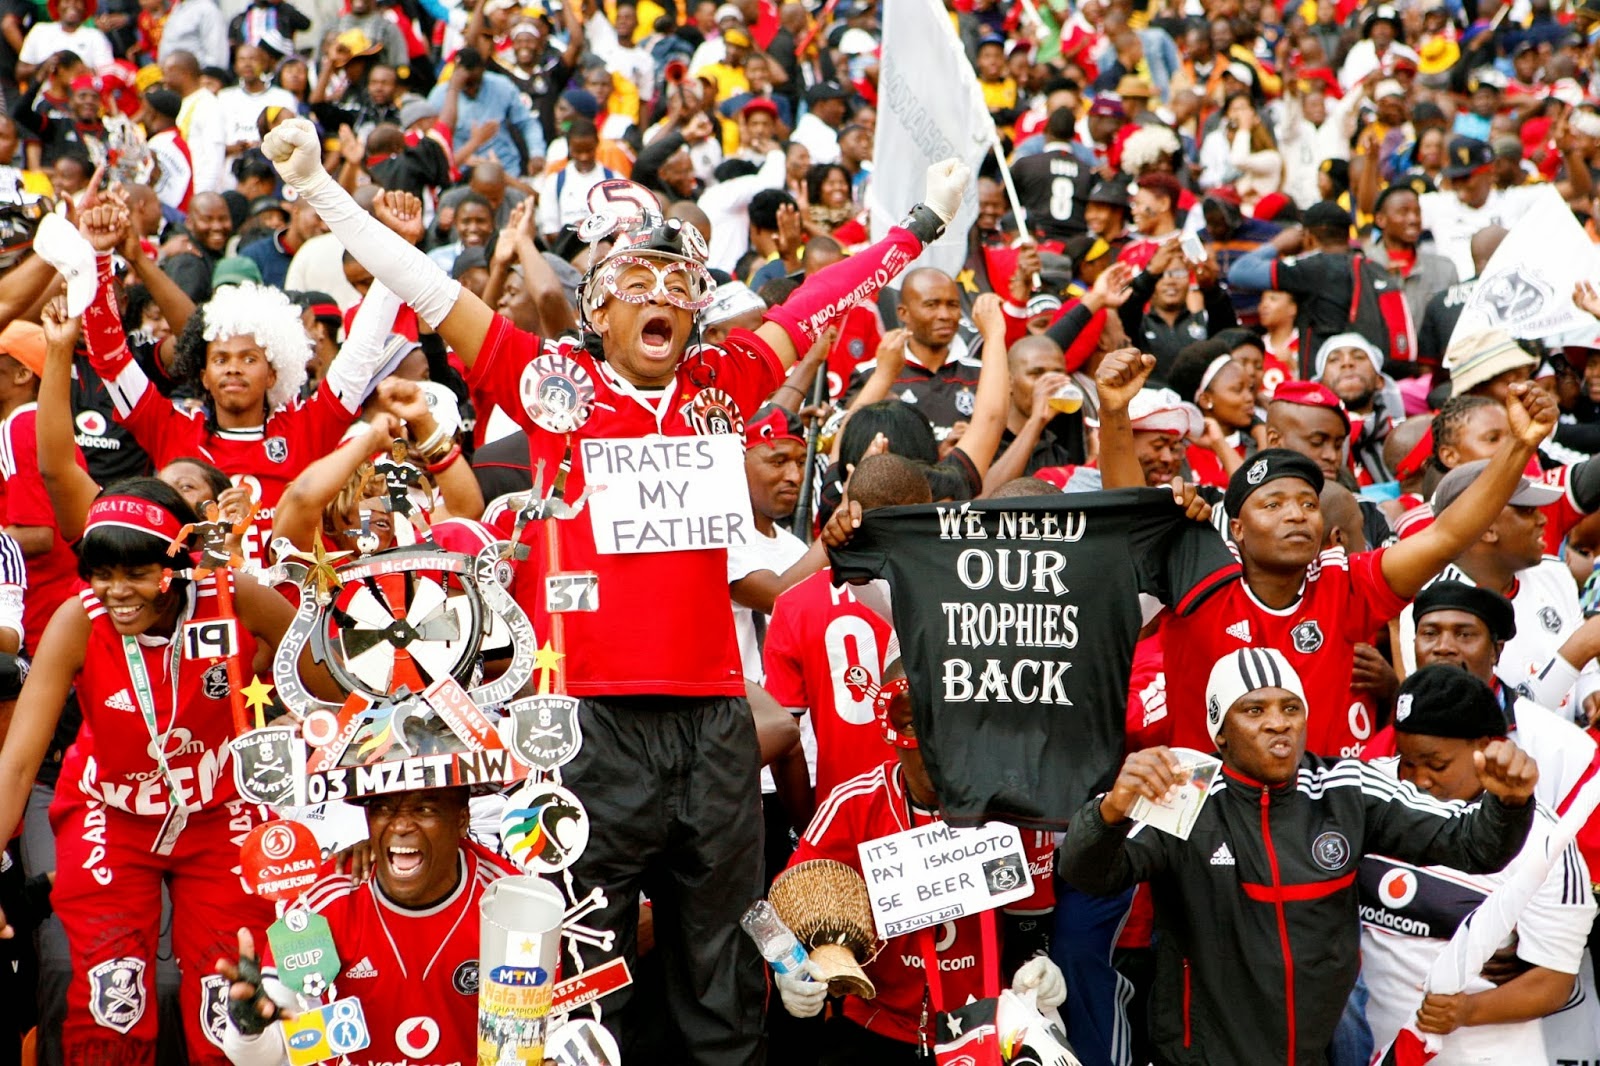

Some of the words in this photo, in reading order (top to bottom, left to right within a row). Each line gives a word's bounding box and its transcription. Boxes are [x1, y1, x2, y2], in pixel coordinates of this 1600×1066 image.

[1050, 177, 1074, 221] 8
[638, 480, 689, 510] MY
[613, 513, 747, 551] FATHER
[936, 502, 989, 540] WE
[996, 511, 1087, 543] NEED
[956, 548, 1070, 597] OUR
[548, 577, 597, 611] 37
[188, 623, 230, 658] 19
[941, 602, 1080, 649] TROPHIES
[1225, 627, 1252, 643] adidas
[942, 658, 1074, 706] BACK
[104, 700, 136, 712] adidas
[459, 702, 491, 740] ABSA
[515, 700, 572, 713] ORLANDO
[234, 732, 290, 750] ORLANDO
[522, 739, 572, 759] PIRATES
[246, 772, 294, 793] PIRATES
[308, 770, 348, 803] 03
[355, 754, 453, 797] MZET
[458, 750, 514, 784] NW
[867, 842, 898, 863] IT'S
[912, 826, 961, 848] TIME
[872, 863, 904, 884] PAY
[923, 835, 1013, 870] ISKOLOTO
[283, 859, 316, 874] ABSA
[878, 893, 903, 913] SE
[916, 872, 975, 902] BEER
[906, 915, 934, 930] JULY
[1359, 905, 1431, 936] vodacom
[283, 949, 323, 971] CUP
[346, 969, 378, 979] adidas
[500, 970, 537, 985] MTN
